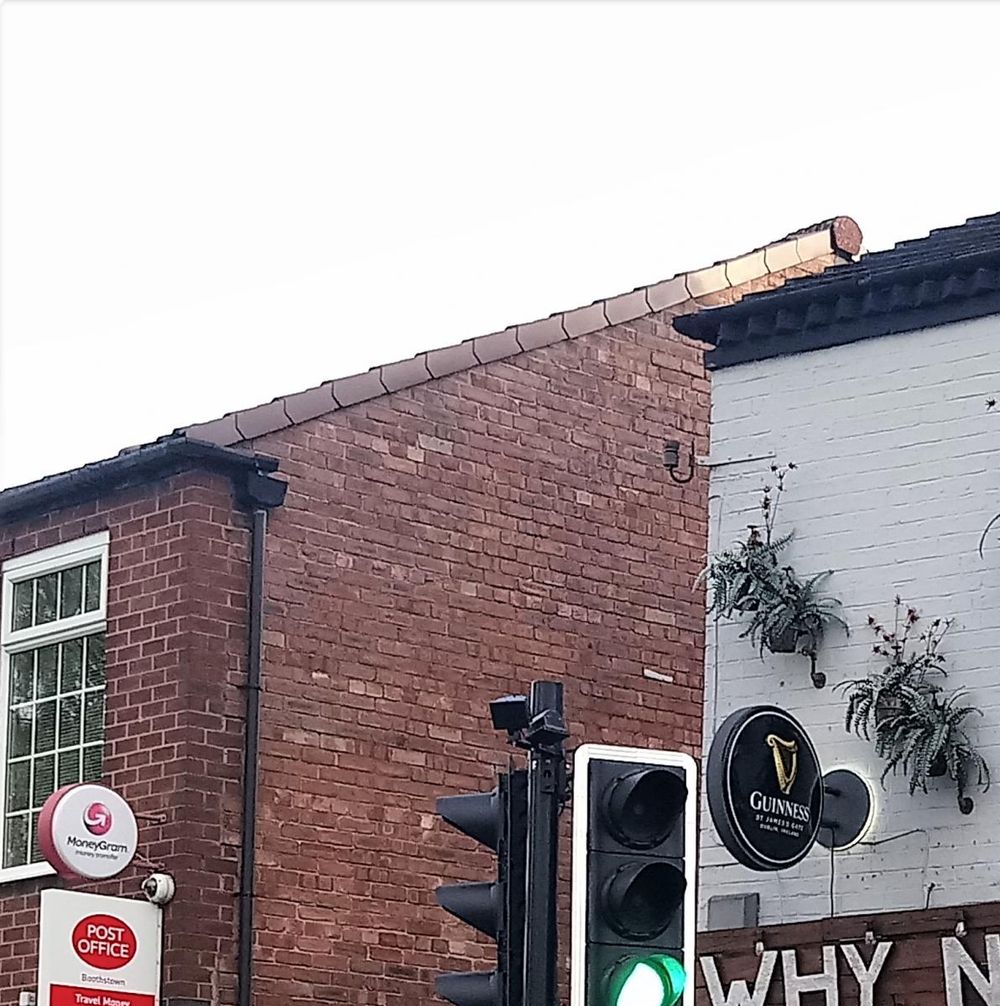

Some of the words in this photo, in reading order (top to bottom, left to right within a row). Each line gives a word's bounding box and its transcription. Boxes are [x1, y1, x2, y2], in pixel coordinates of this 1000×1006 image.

[750, 791, 810, 822] GUINNESS
[67, 836, 128, 853] MoneyGram
[87, 924, 125, 942] POST
[78, 939, 130, 958] OFFICE
[75, 993, 101, 1006] Travel
